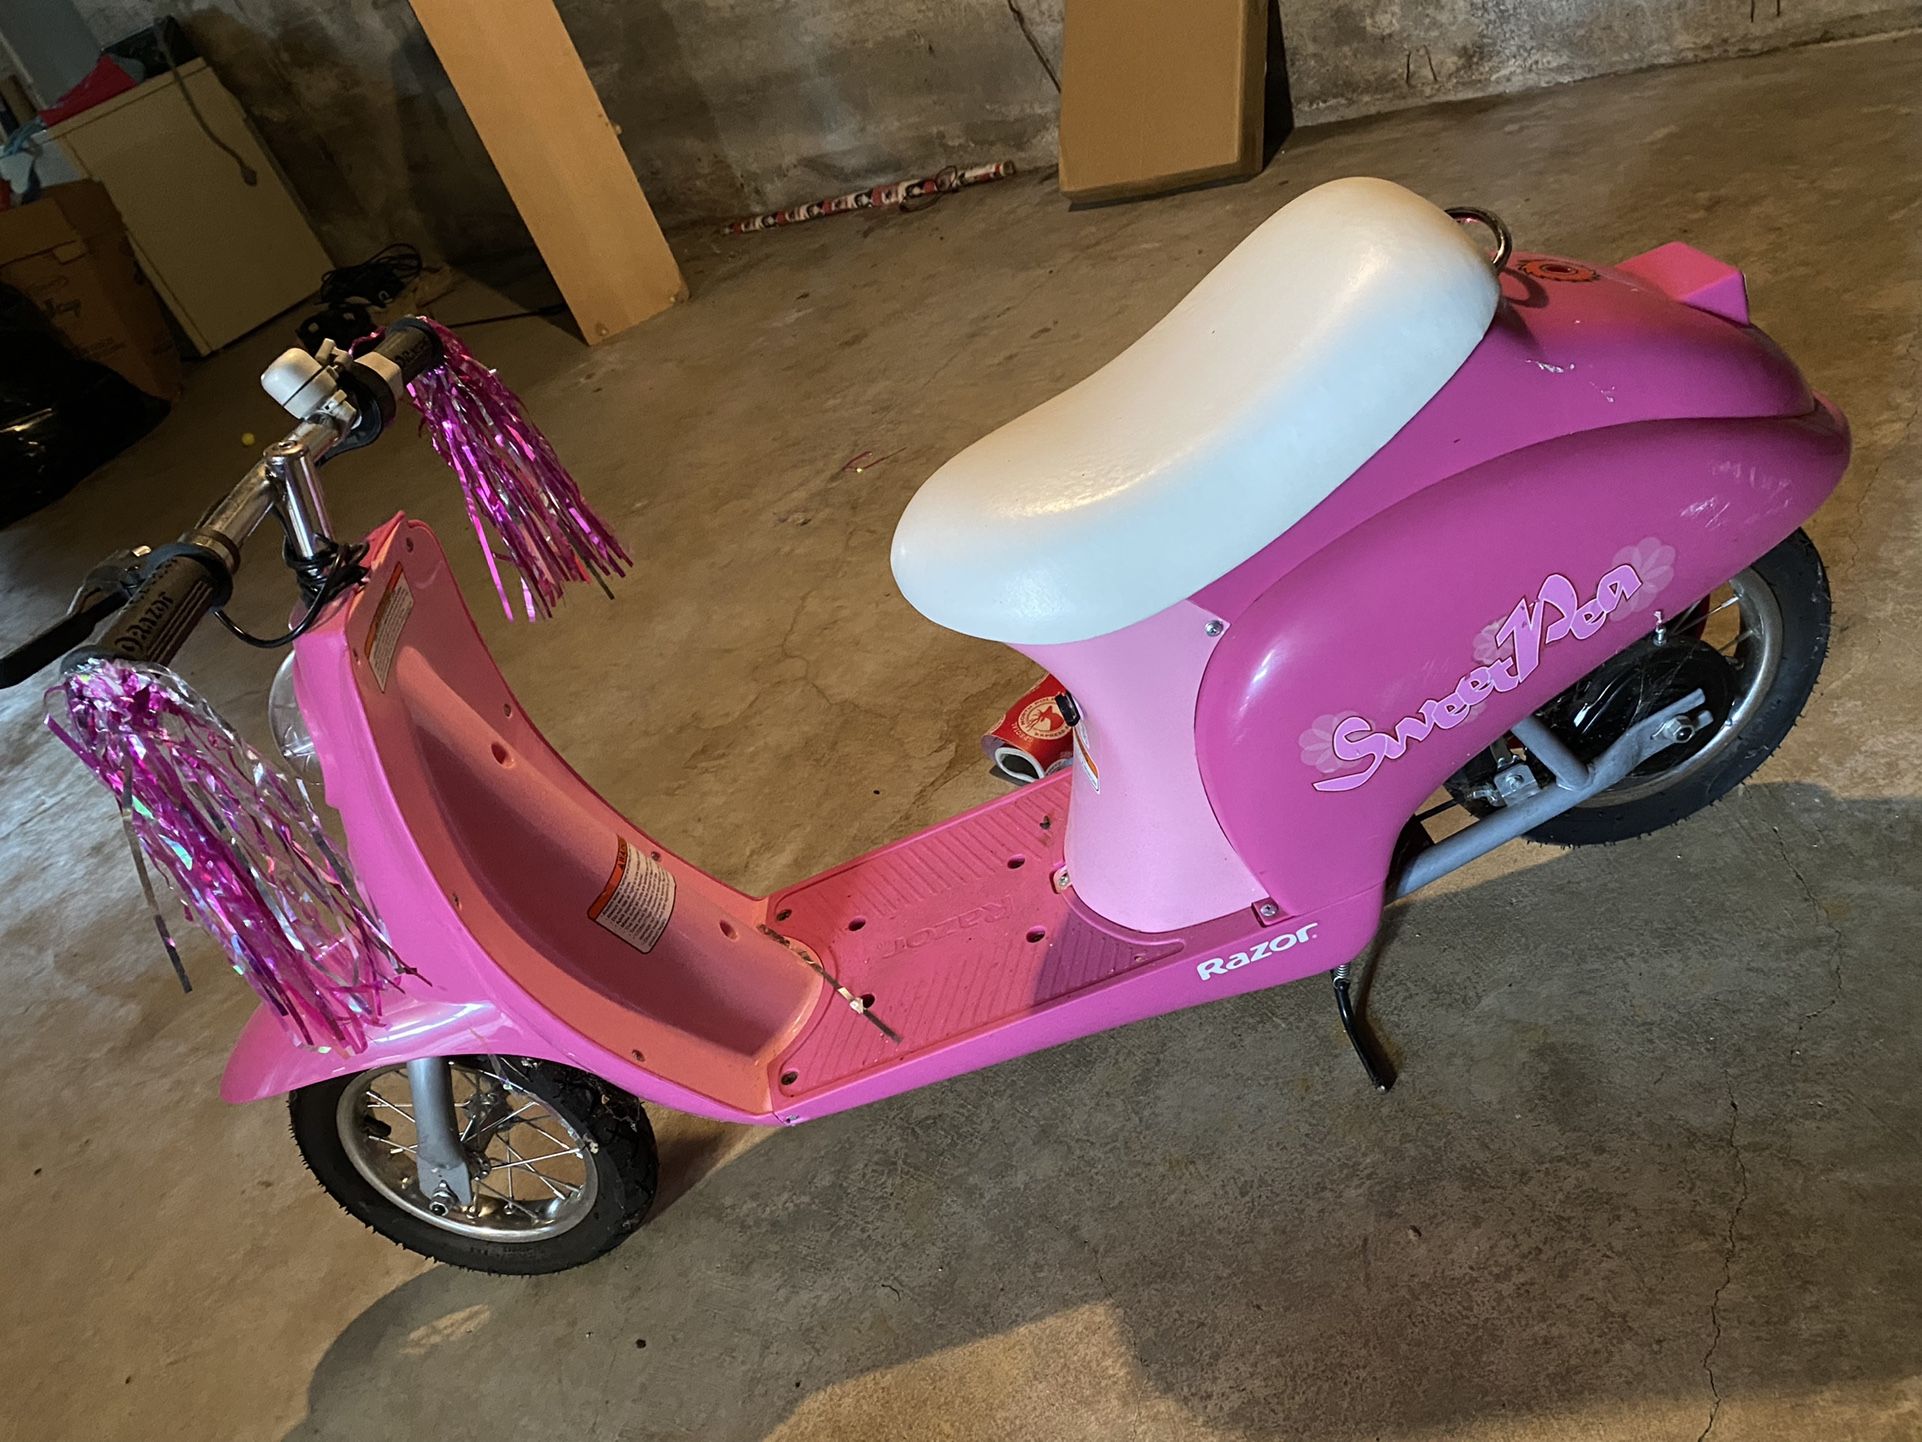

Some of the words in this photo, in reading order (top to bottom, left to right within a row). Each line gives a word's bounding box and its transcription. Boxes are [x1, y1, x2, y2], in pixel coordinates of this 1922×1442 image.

[1312, 656, 1519, 792] Sweet
[1495, 563, 1643, 684] Pea
[1196, 922, 1318, 981] Razor
